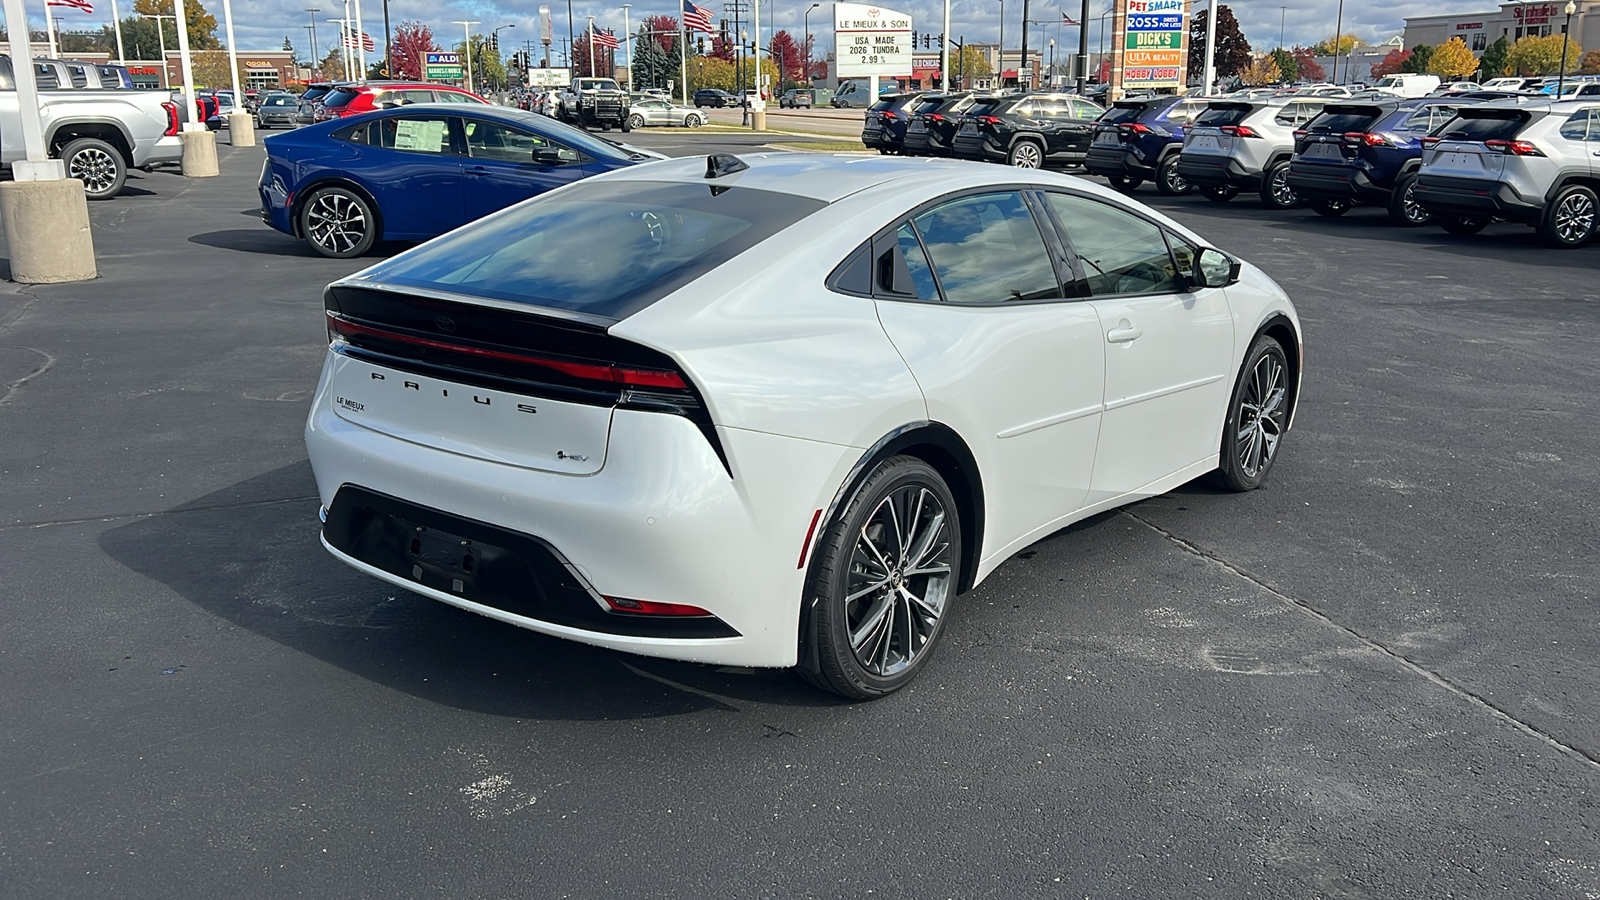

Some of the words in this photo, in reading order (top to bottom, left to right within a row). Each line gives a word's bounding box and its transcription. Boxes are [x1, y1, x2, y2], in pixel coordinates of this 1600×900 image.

[1129, 0, 1182, 12] PETSMART
[1128, 18, 1159, 28] ROSS
[855, 36, 869, 44] USA
[875, 36, 895, 44] MADE
[1137, 33, 1171, 45] DICK'S
[850, 46, 867, 54] 2026
[872, 46, 900, 54] TUNDRA
[861, 56, 878, 64] 2.99
[1128, 53, 1151, 62] ULTA
[1125, 69, 1150, 79] HOBBY
[1153, 68, 1178, 78] LOBBY
[371, 372, 537, 414] PRIUS
[337, 396, 344, 404] LE
[345, 399, 364, 411] MIEUX
